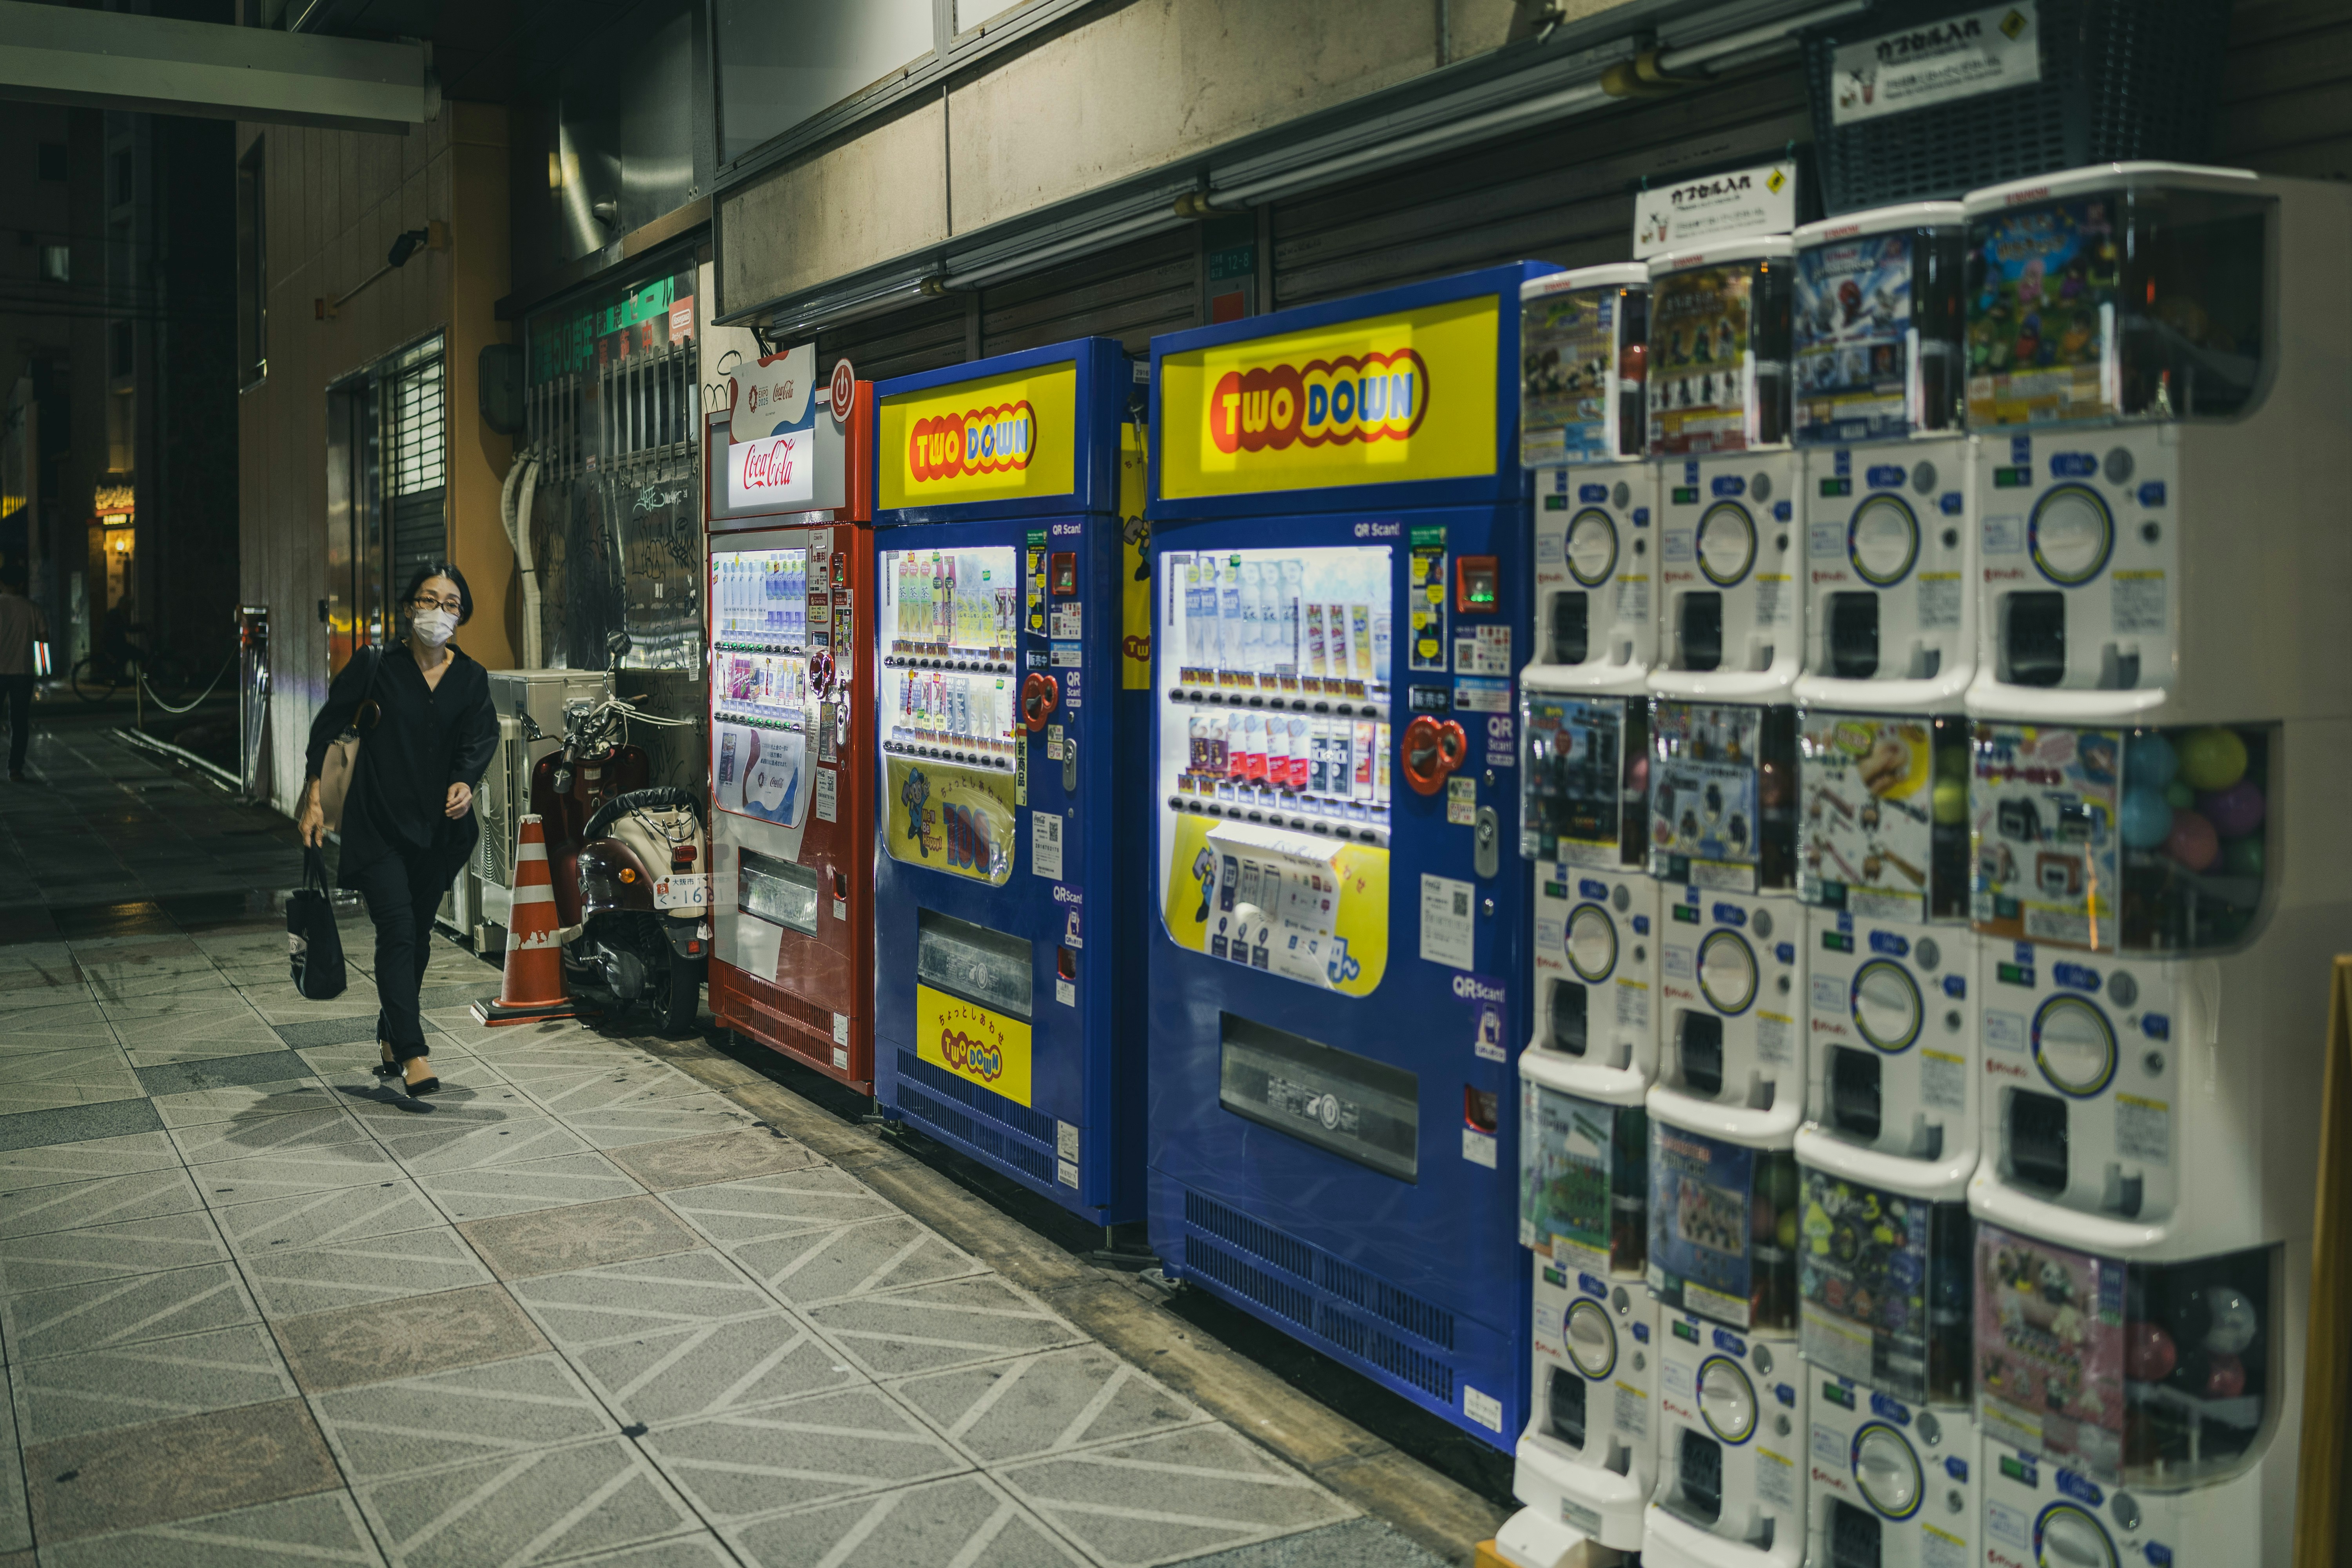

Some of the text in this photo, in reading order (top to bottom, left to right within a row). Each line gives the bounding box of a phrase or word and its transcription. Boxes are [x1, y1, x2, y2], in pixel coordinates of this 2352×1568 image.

[1228, 252, 1249, 270] 12-8
[672, 313, 690, 325] Hasegawa
[759, 388, 768, 398] EXPO
[773, 379, 794, 402] Coca-Cola
[759, 398, 768, 407] 2025
[1222, 372, 1413, 435] TWO DOWN
[916, 418, 1028, 467] TWO DOWN
[743, 438, 797, 490] Coca-Cola
[1053, 524, 1062, 535] QR
[1063, 523, 1081, 534] Scan!
[1354, 521, 1400, 538] QR Scan!
[814, 637, 828, 645] 販売中
[1128, 641, 1149, 657] TW
[1029, 655, 1047, 666] 販売中
[1067, 671, 1080, 686] QR
[1067, 687, 1081, 697] Scan!
[1487, 716, 1514, 739] QR
[915, 731, 924, 740] 100
[926, 732, 936, 742] 100
[939, 734, 949, 743] 100
[952, 736, 961, 746] 100
[964, 738, 974, 748] 100
[978, 740, 987, 750] 100
[991, 742, 1001, 752] 100
[1004, 744, 1014, 755] 100
[941, 776, 1003, 805] ちょっとしあわせ
[922, 808, 935, 824] We'll
[922, 821, 931, 834] Be
[922, 834, 942, 852] Happy!
[1053, 886, 1082, 904] QR Scan!
[1452, 975, 1504, 1004] QR Scan!
[939, 1005, 1004, 1045] ちょっとしあわせ
[945, 1036, 998, 1075] TWO DOWN
